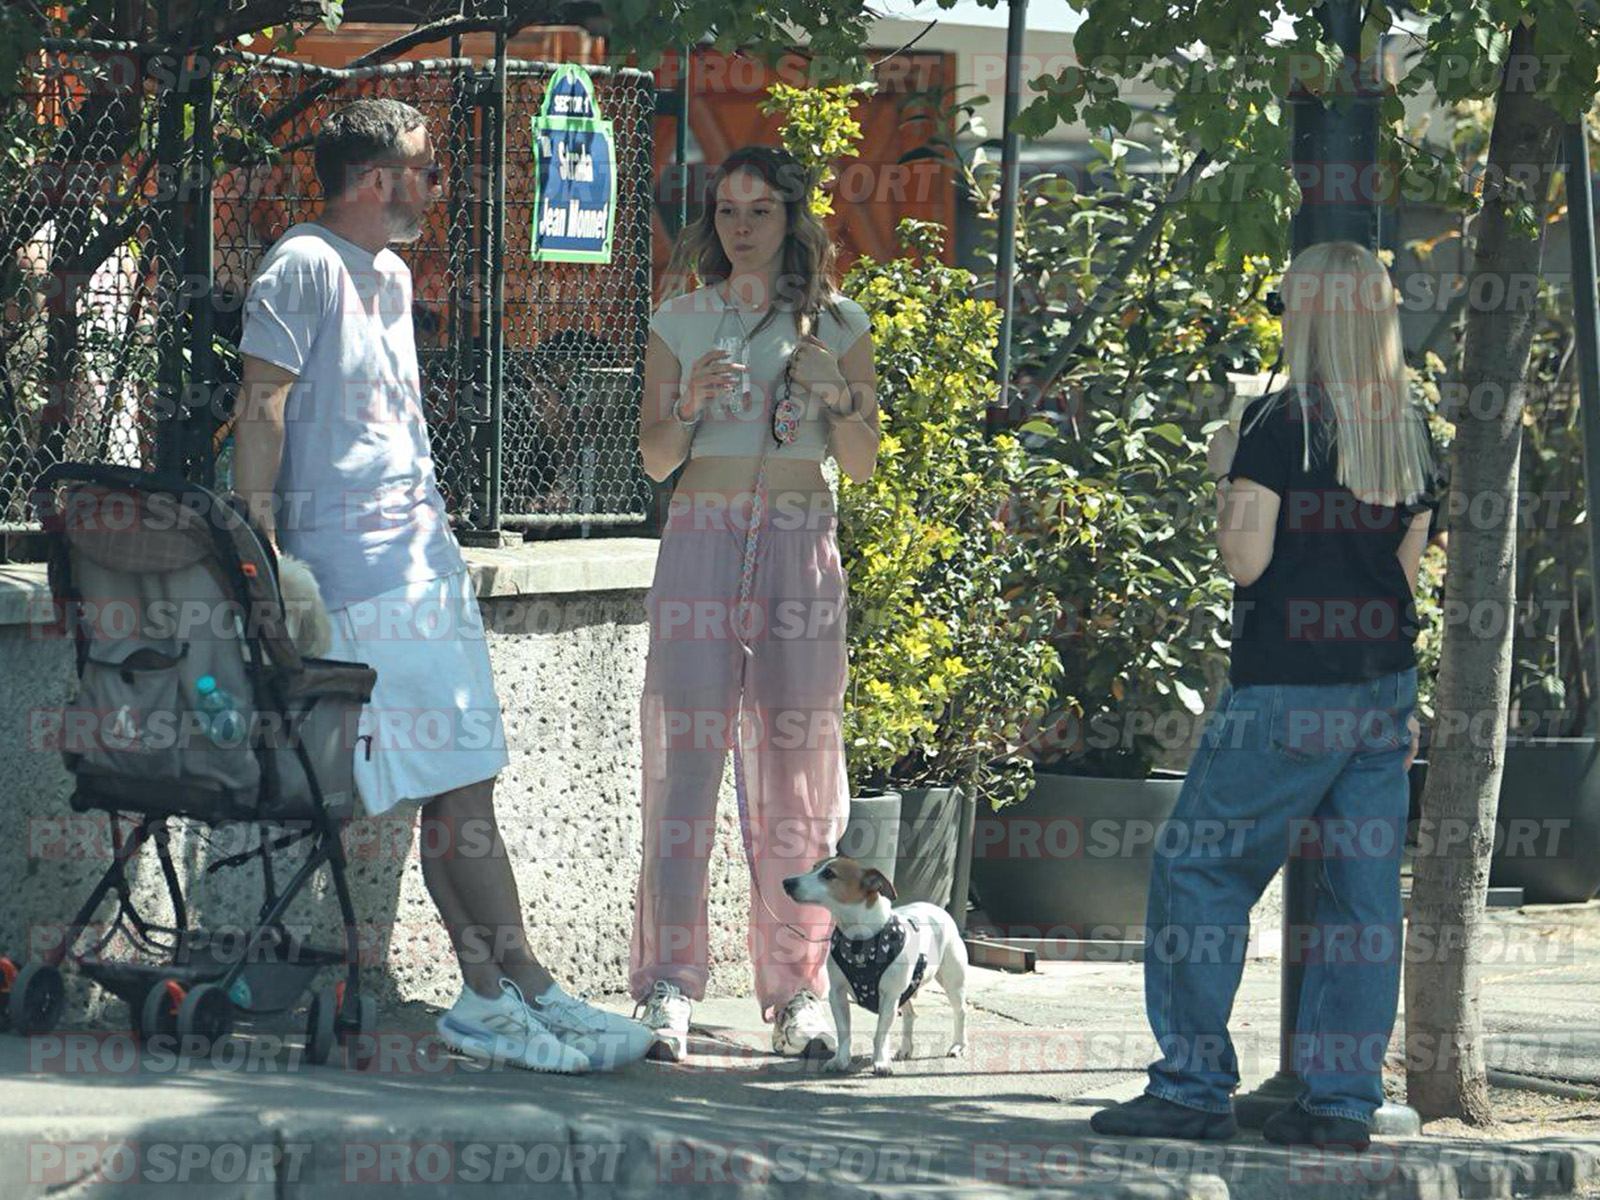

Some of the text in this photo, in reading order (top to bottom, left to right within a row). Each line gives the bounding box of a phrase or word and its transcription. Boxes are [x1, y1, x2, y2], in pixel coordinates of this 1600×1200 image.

[584, 96, 589, 114] 1
[539, 197, 608, 239] Jean Monnet
